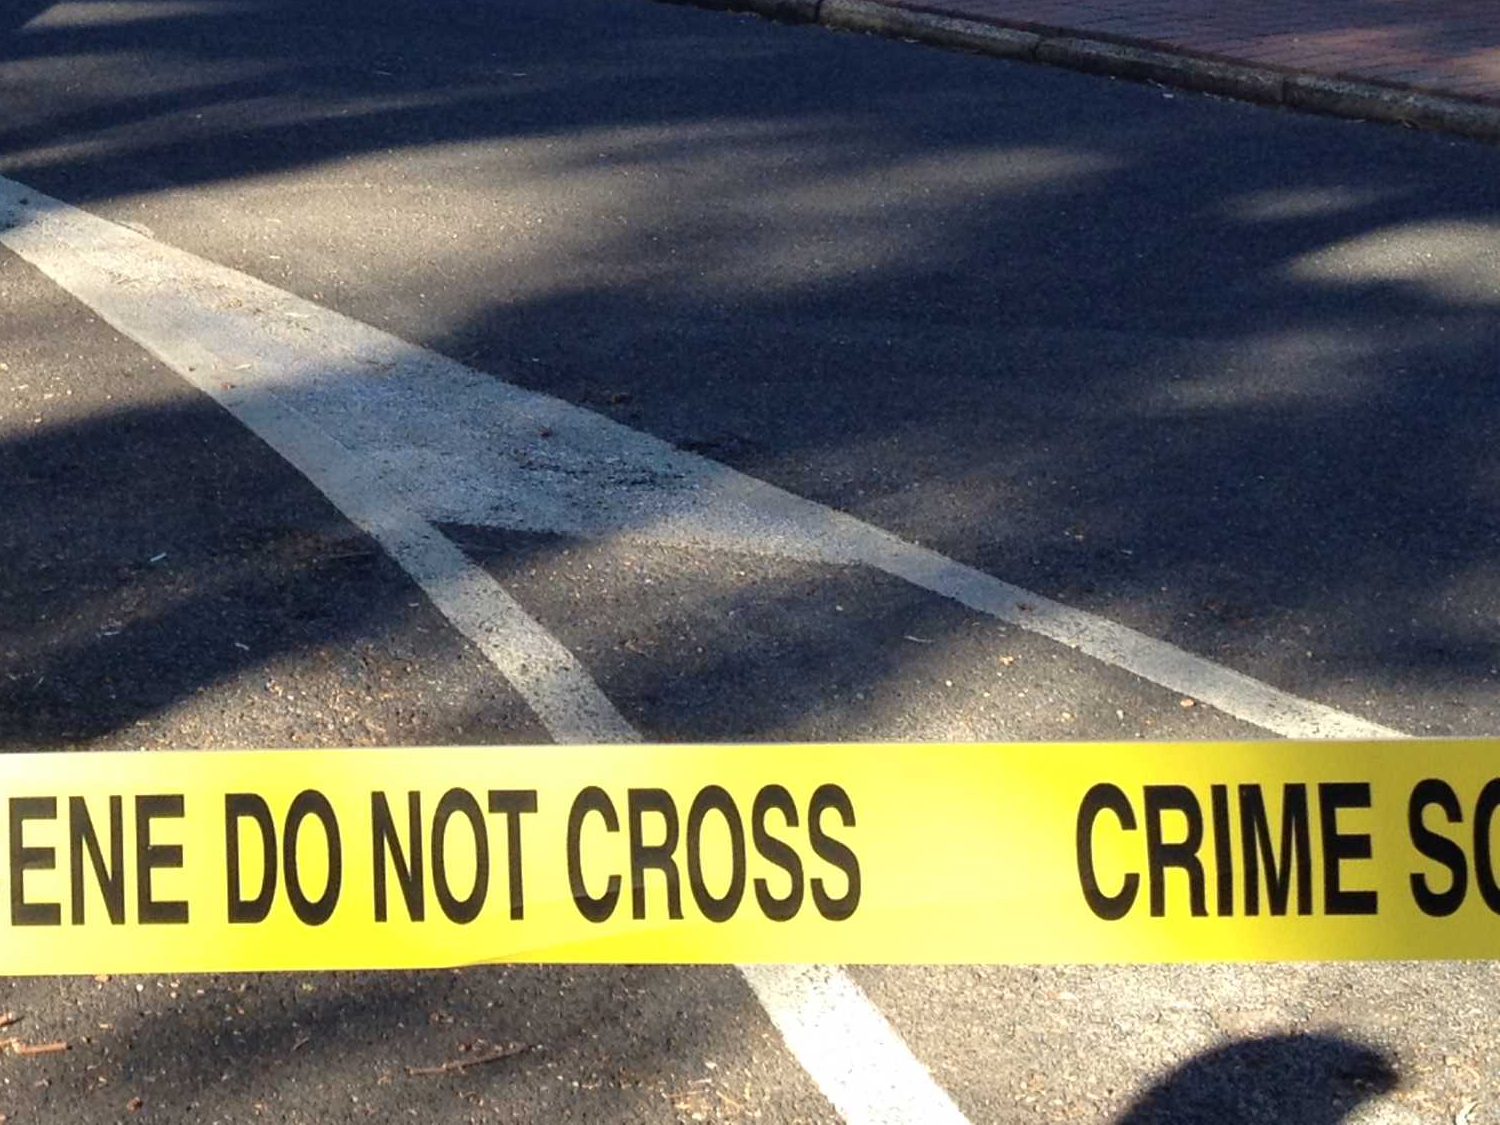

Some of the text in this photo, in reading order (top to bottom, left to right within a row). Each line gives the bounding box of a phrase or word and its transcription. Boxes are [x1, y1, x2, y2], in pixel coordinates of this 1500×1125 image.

[225, 789, 342, 926] DO
[371, 788, 537, 922] NOT
[567, 783, 861, 923] CROSS
[1076, 781, 1379, 921] CRIME
